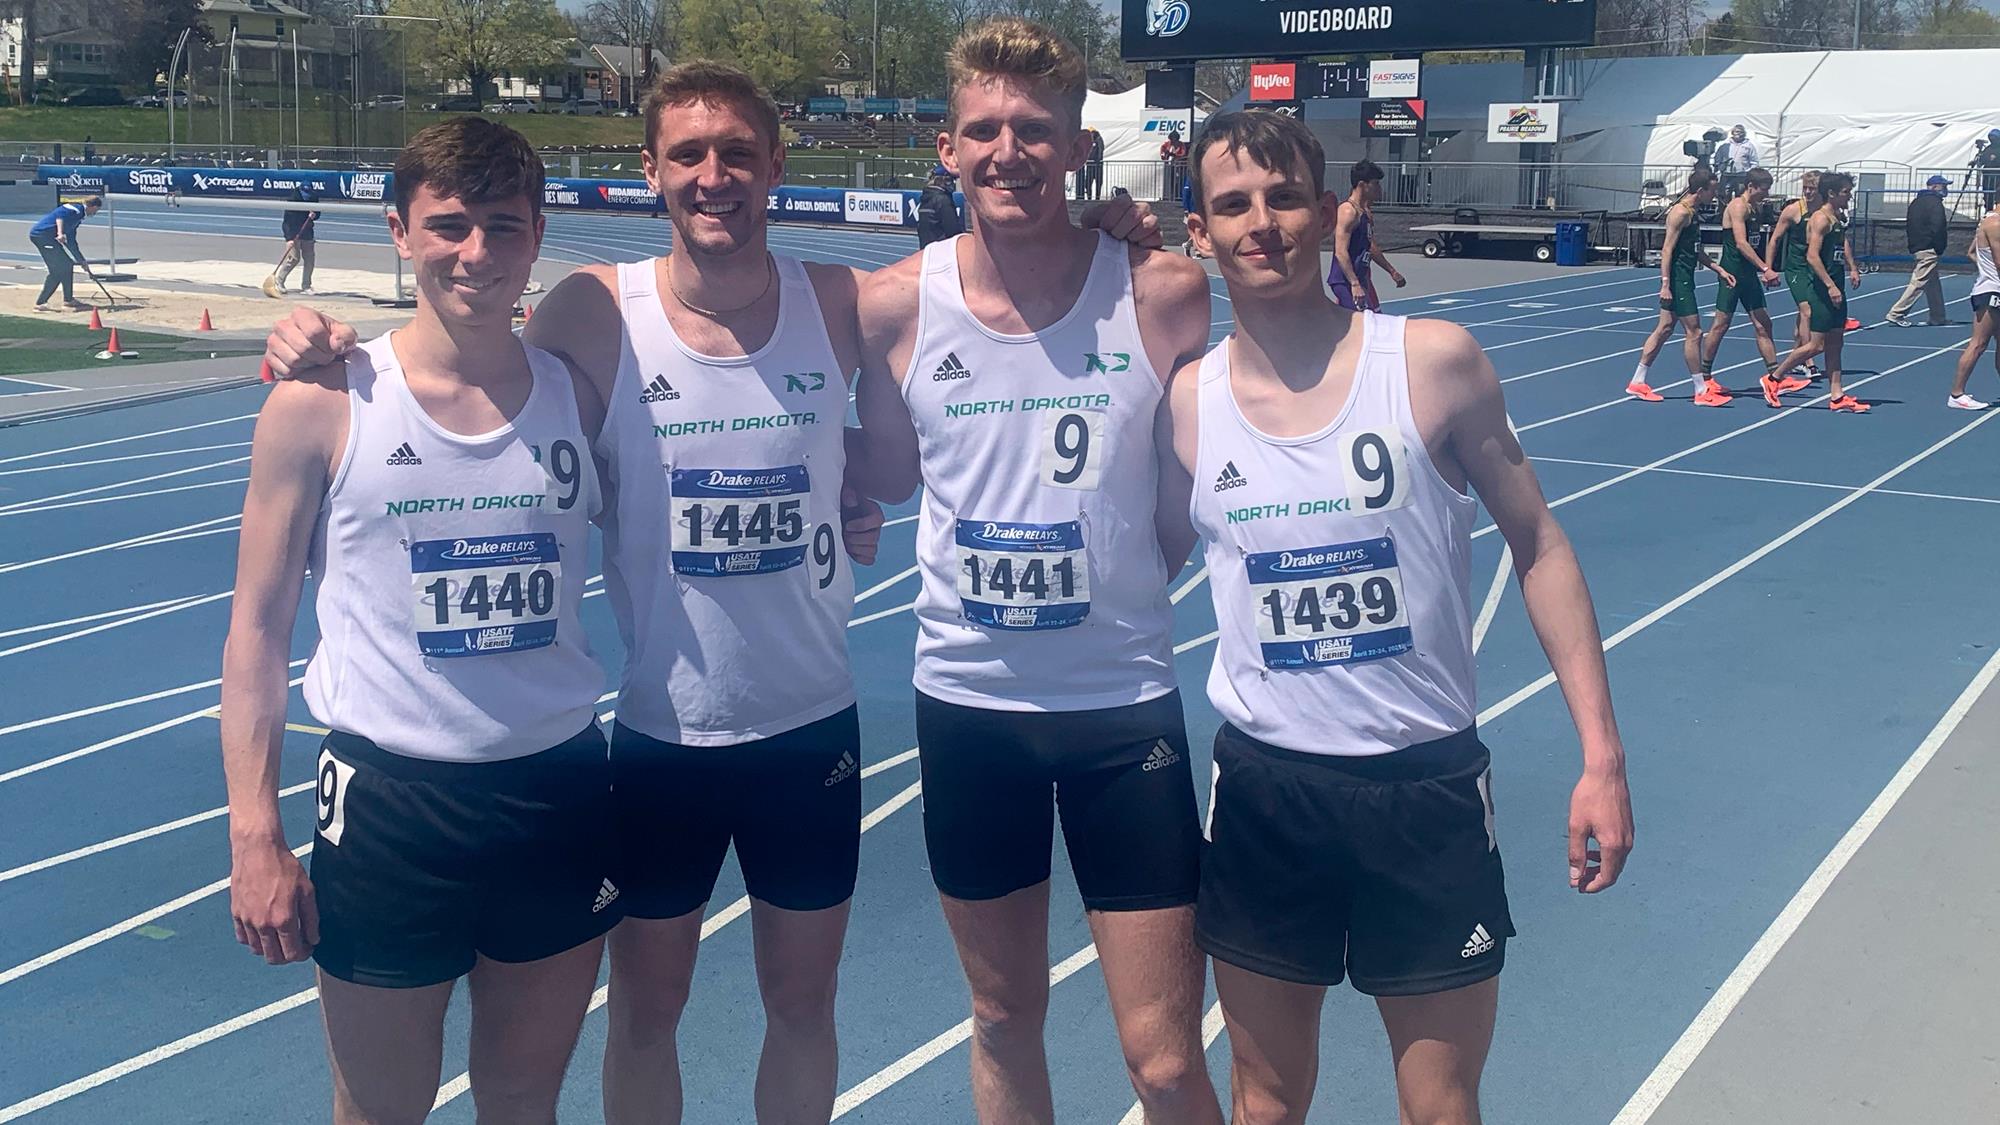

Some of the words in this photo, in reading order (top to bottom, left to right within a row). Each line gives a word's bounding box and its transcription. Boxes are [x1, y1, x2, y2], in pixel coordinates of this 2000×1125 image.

[1280, 6, 1393, 33] VIDEOBOARD
[1323, 68, 1369, 92] 1:44
[1159, 120, 1186, 131] EMC
[129, 169, 173, 186] Smart
[207, 177, 254, 186] XTREAM
[273, 181, 295, 189] DELTA
[295, 182, 325, 190] DTAL
[355, 174, 386, 184] USATF
[140, 185, 168, 193] Honda
[357, 189, 382, 198] SERIES
[545, 191, 556, 203] DES
[557, 192, 579, 205] MOINES
[608, 196, 629, 204] ENERGY
[631, 197, 657, 205] COMPANY
[794, 201, 814, 211] DELTA
[814, 202, 840, 212] DENTAL
[859, 200, 900, 213] GRINNELL
[933, 368, 971, 382] adidas
[639, 389, 681, 404] adidas
[944, 400, 1014, 419] NORTH
[1021, 394, 1110, 411] DAKOTA
[652, 420, 724, 439] NORTH
[732, 412, 817, 431] DAKOTA
[1053, 414, 1089, 484] 9
[386, 456, 422, 466] adidas
[551, 439, 581, 510] 9
[708, 470, 752, 486] Drake
[753, 474, 787, 485] RELAYS
[1352, 432, 1395, 509] 9
[1214, 477, 1247, 493] adidas
[384, 498, 464, 518] NORTH
[472, 494, 546, 509] DAKOT
[1225, 503, 1289, 525] NORTH
[1298, 498, 1352, 515] DAK
[682, 500, 803, 546] 1445
[983, 522, 1024, 540] Drake
[1024, 531, 1059, 540] RELAYS
[452, 540, 499, 557] Drake
[500, 540, 536, 553] RELAYS
[731, 552, 762, 561] USATF
[813, 523, 836, 589] 9
[1280, 552, 1325, 569] Drake
[1326, 549, 1364, 563] RELAYS
[964, 554, 1075, 600] 1441
[425, 570, 554, 625] 1440
[1262, 576, 1396, 636] 1439
[1007, 607, 1038, 615] USATF
[482, 626, 515, 637] USATF
[484, 639, 511, 649] SERIES
[1319, 637, 1353, 648] USATF
[1321, 650, 1350, 659] SERIES
[1142, 752, 1181, 772] adidas
[824, 762, 858, 787] adidas
[318, 760, 337, 831] 9
[592, 888, 620, 913] adidas
[1461, 938, 1495, 958] adidas
